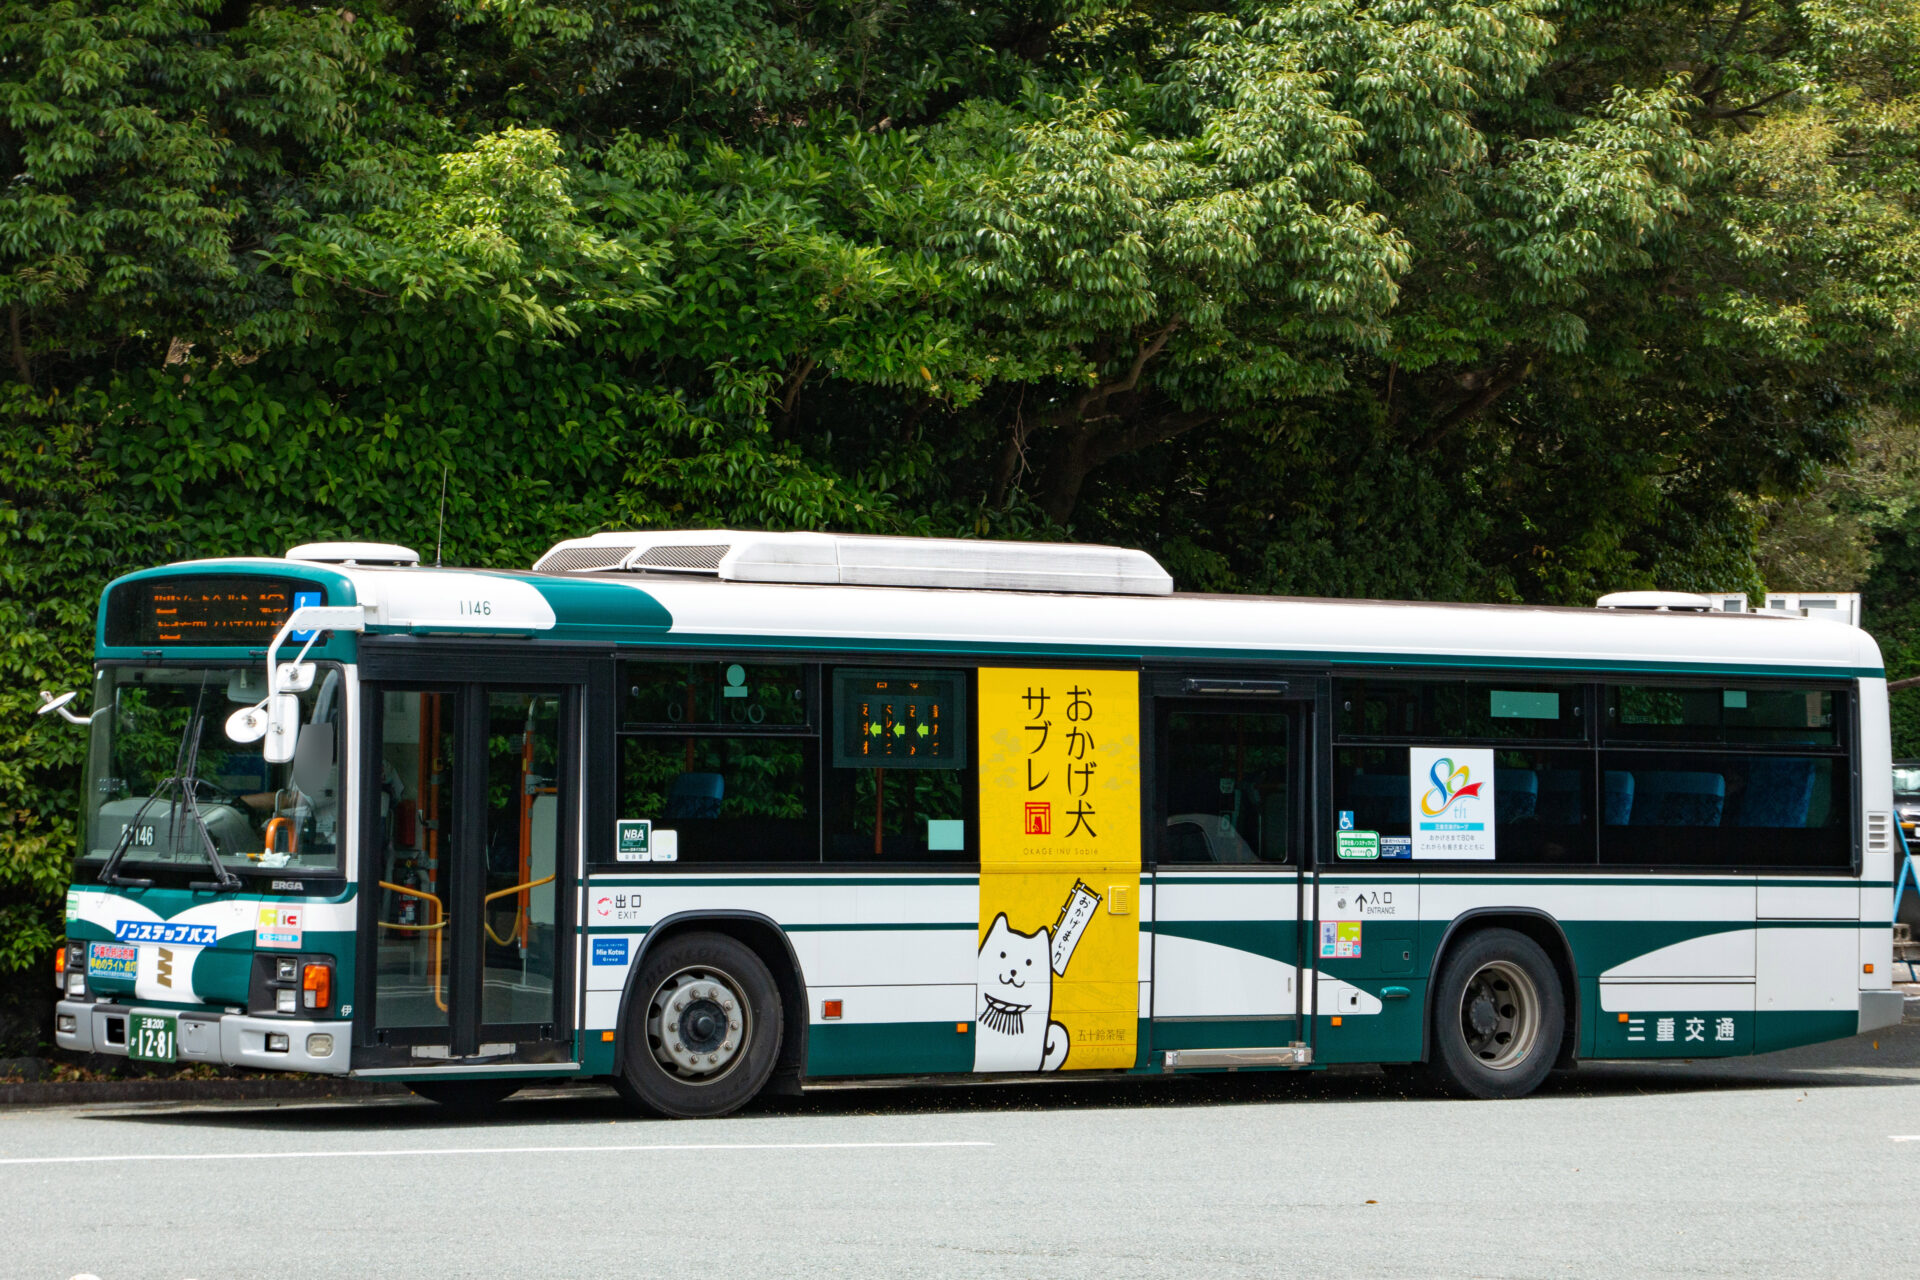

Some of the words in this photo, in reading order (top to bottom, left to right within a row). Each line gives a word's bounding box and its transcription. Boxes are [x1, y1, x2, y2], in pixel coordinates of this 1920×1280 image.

[459, 600, 491, 616] 1146
[1021, 686, 1052, 792] サブレ
[1065, 684, 1098, 839] おかげ犬
[623, 829, 645, 840] NBA
[1023, 847, 1053, 856] OKAGE
[271, 881, 304, 891] ERGA
[615, 893, 642, 909] 出口
[1370, 891, 1393, 905] 入口
[617, 911, 639, 920] EXIT
[1367, 906, 1396, 915] ENTRANCE
[116, 923, 216, 944] ノンステップバス
[341, 1004, 352, 1017] 伊
[1627, 1017, 1735, 1042] 三重交通
